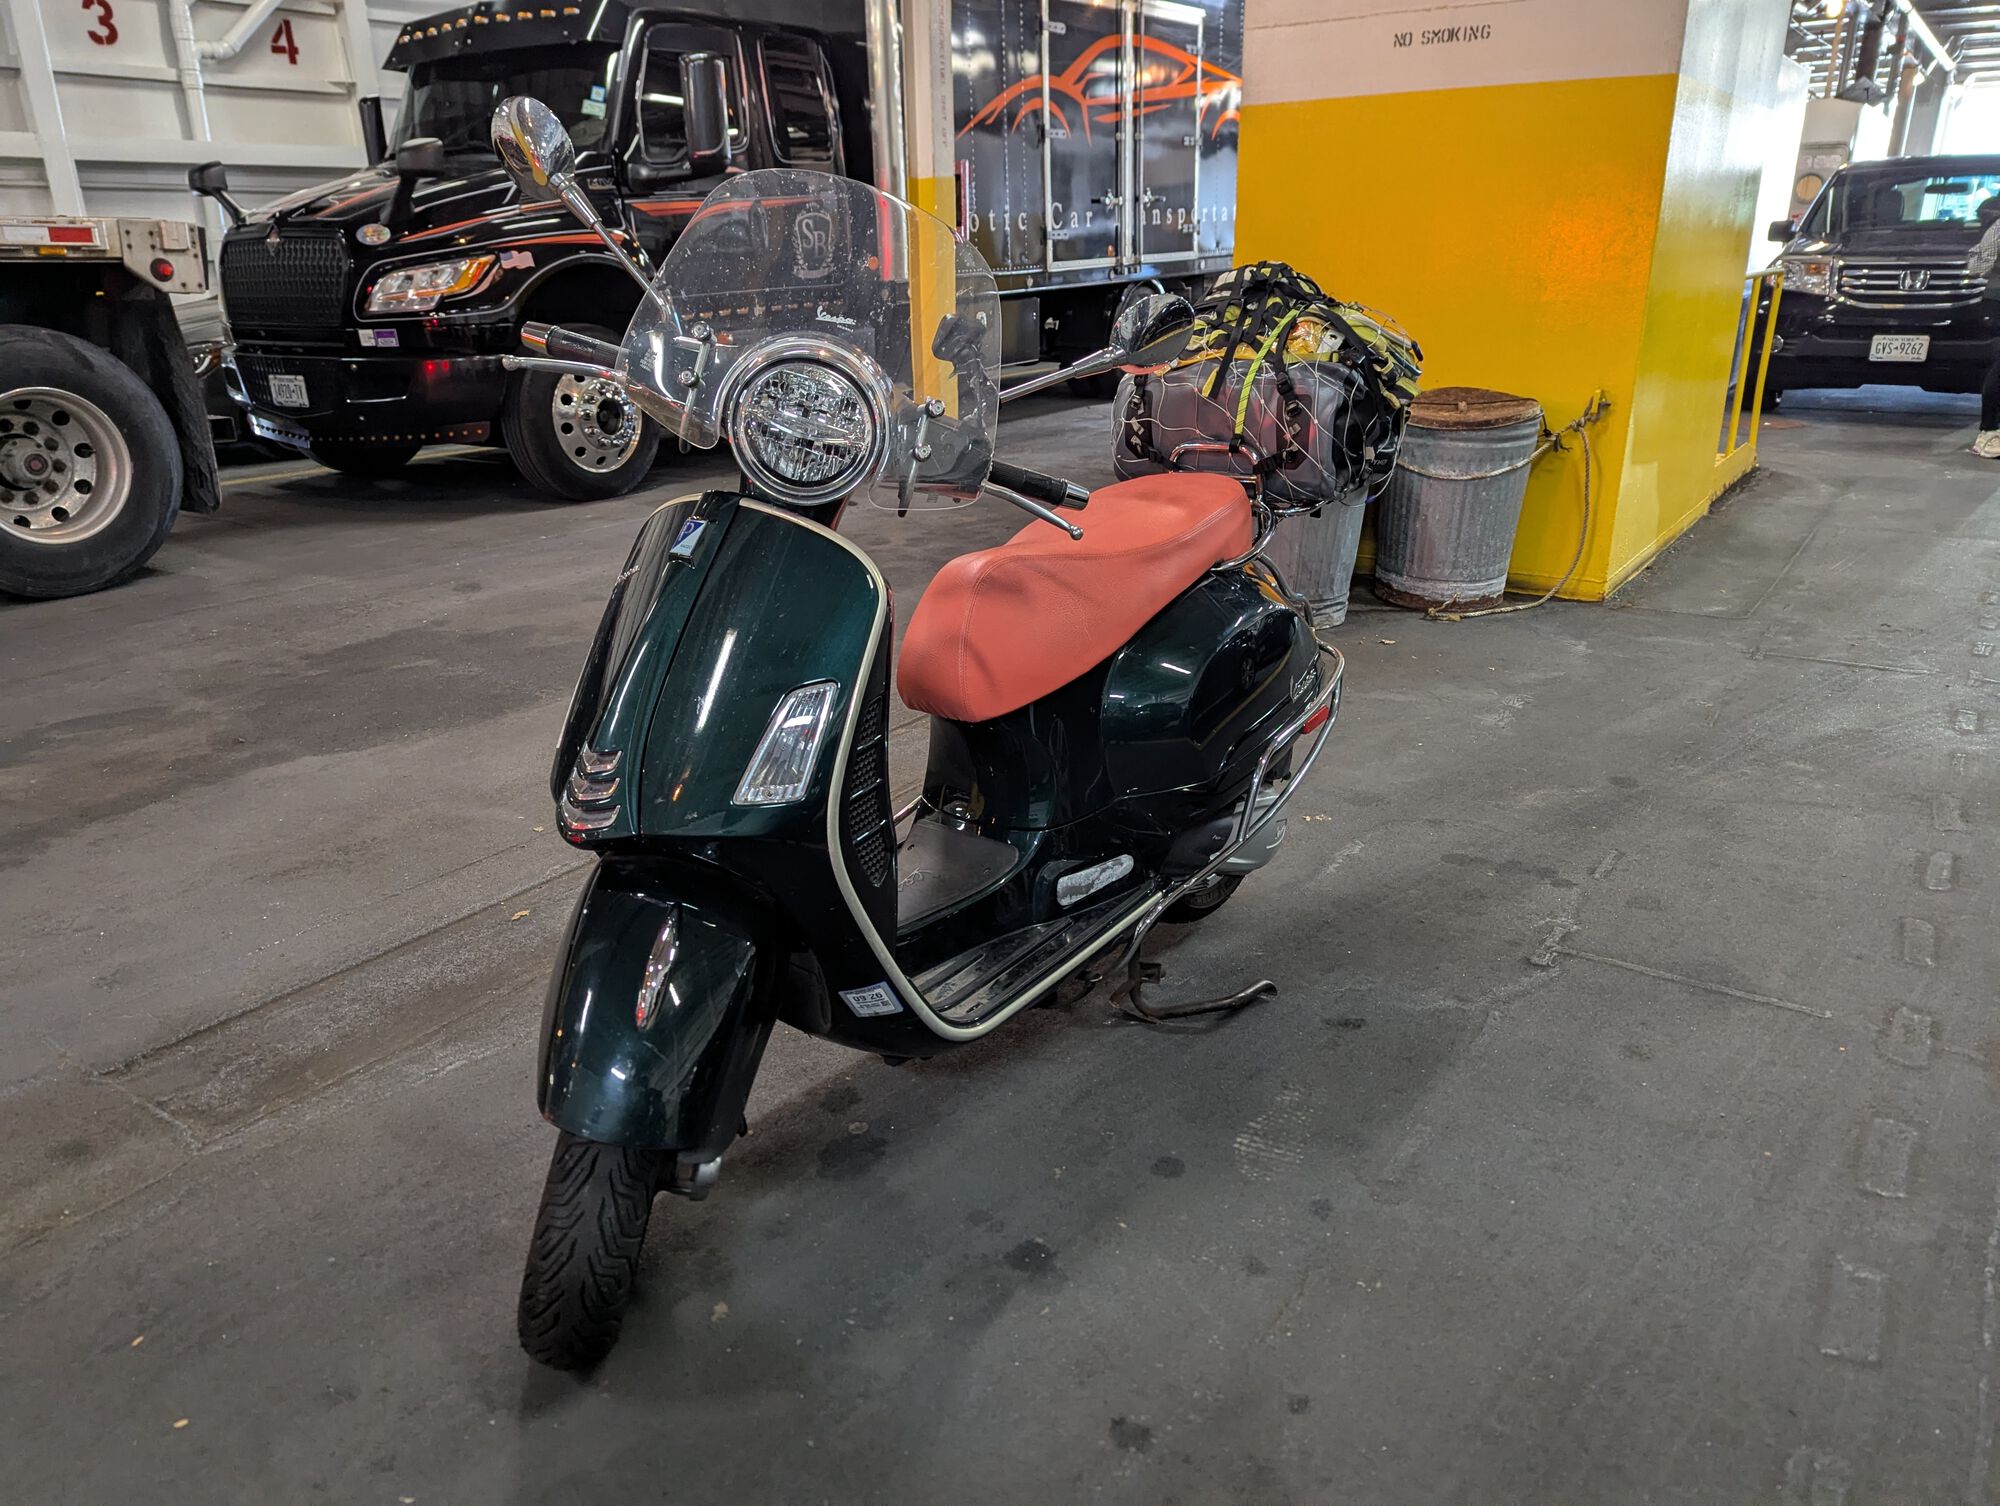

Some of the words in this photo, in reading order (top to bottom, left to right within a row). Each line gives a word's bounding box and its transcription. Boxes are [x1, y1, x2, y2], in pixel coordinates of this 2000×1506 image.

[82, 0, 118, 46] 3
[1393, 31, 1413, 48] NO
[1421, 24, 1491, 45] SMOKING
[270, 18, 299, 65] 4
[969, 202, 1028, 232] otic
[1051, 202, 1093, 230] Car
[816, 305, 857, 325] Vespa
